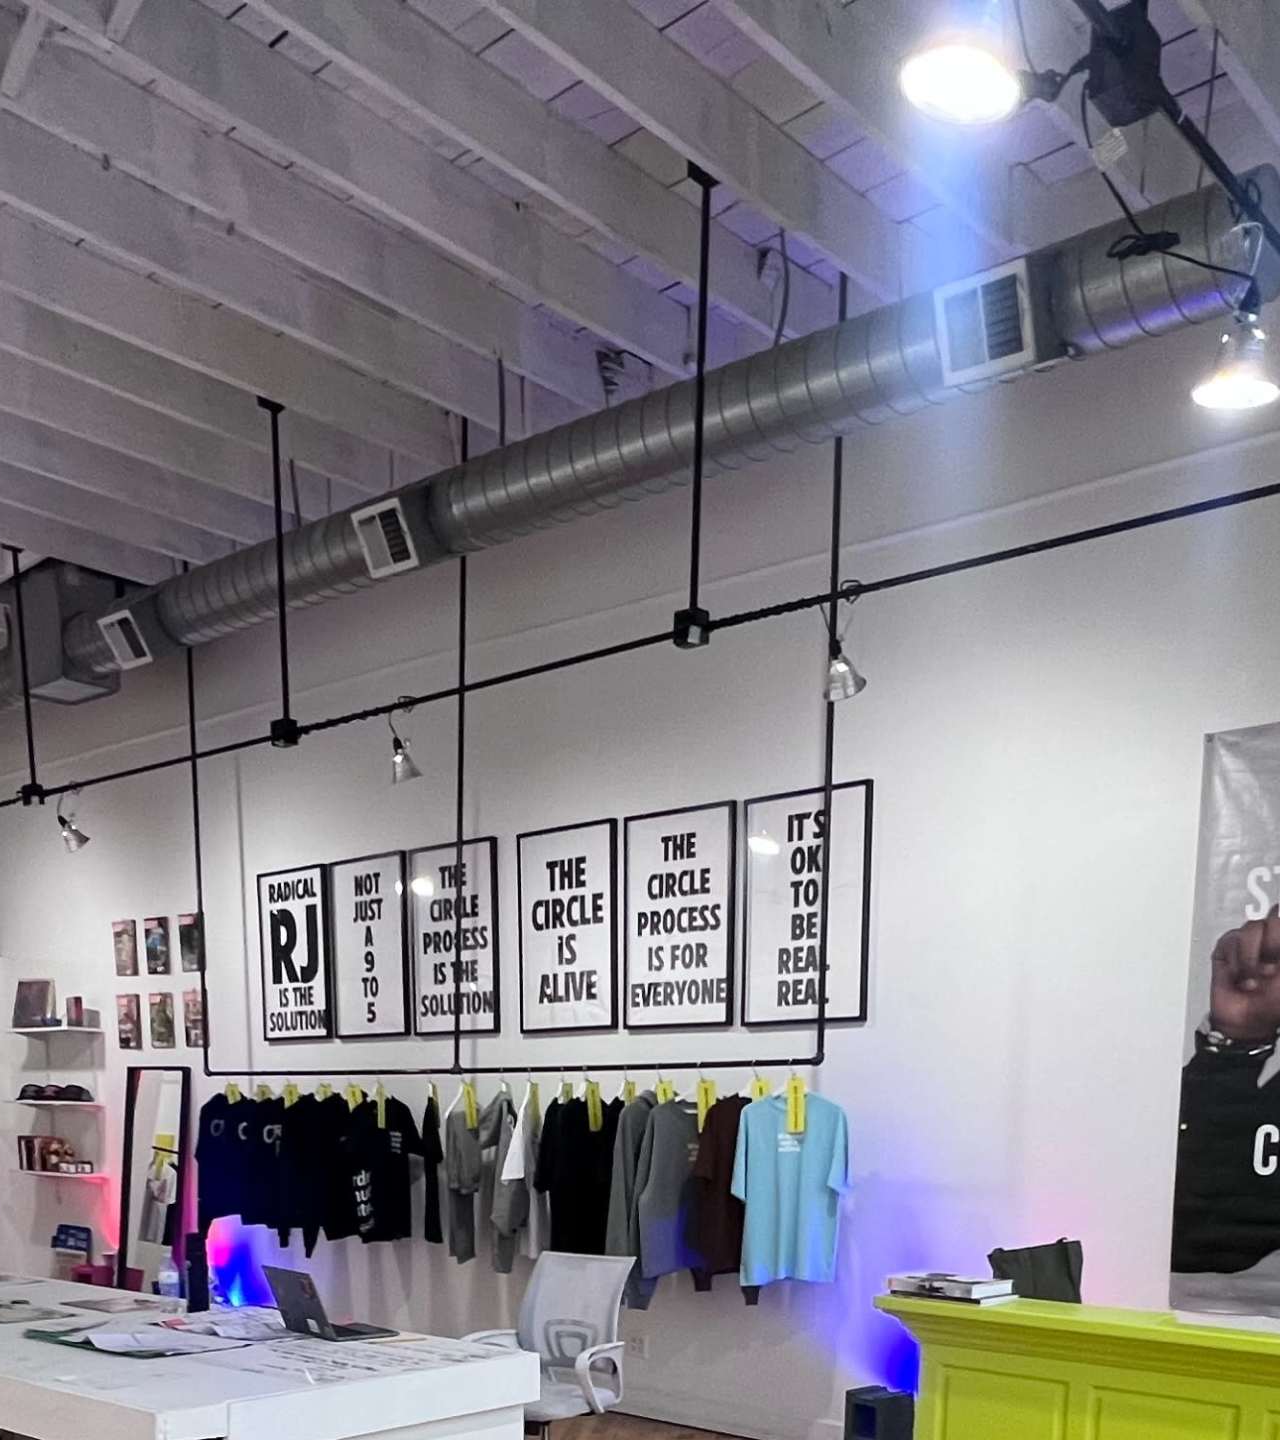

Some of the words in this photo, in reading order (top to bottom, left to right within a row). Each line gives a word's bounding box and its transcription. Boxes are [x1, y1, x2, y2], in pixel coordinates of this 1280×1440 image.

[661, 832, 696, 862] THE
[790, 844, 823, 875] OK
[354, 872, 381, 897] NOT
[546, 856, 587, 892] THE
[647, 868, 710, 900] CIRCLE
[268, 877, 317, 904] RADICAL
[790, 878, 819, 908] TO
[353, 898, 383, 922] JUST
[430, 894, 479, 923] CIRLE
[532, 892, 604, 931] CIRCLE
[637, 904, 721, 937] PROCESS
[364, 925, 374, 947] A
[423, 925, 488, 955] PROESS
[791, 912, 818, 940] BE
[269, 903, 319, 985] RJ
[648, 945, 665, 972] IS
[670, 942, 708, 970] FOR
[364, 950, 375, 972] 9
[433, 962, 446, 985] IS
[279, 987, 289, 1008] IS
[292, 986, 314, 1007] THE
[361, 976, 379, 998] TO
[538, 970, 598, 1004] ALIVE
[631, 976, 728, 1008] EVERYONE
[270, 1009, 329, 1032] SOLUTION
[366, 1001, 376, 1023] 5
